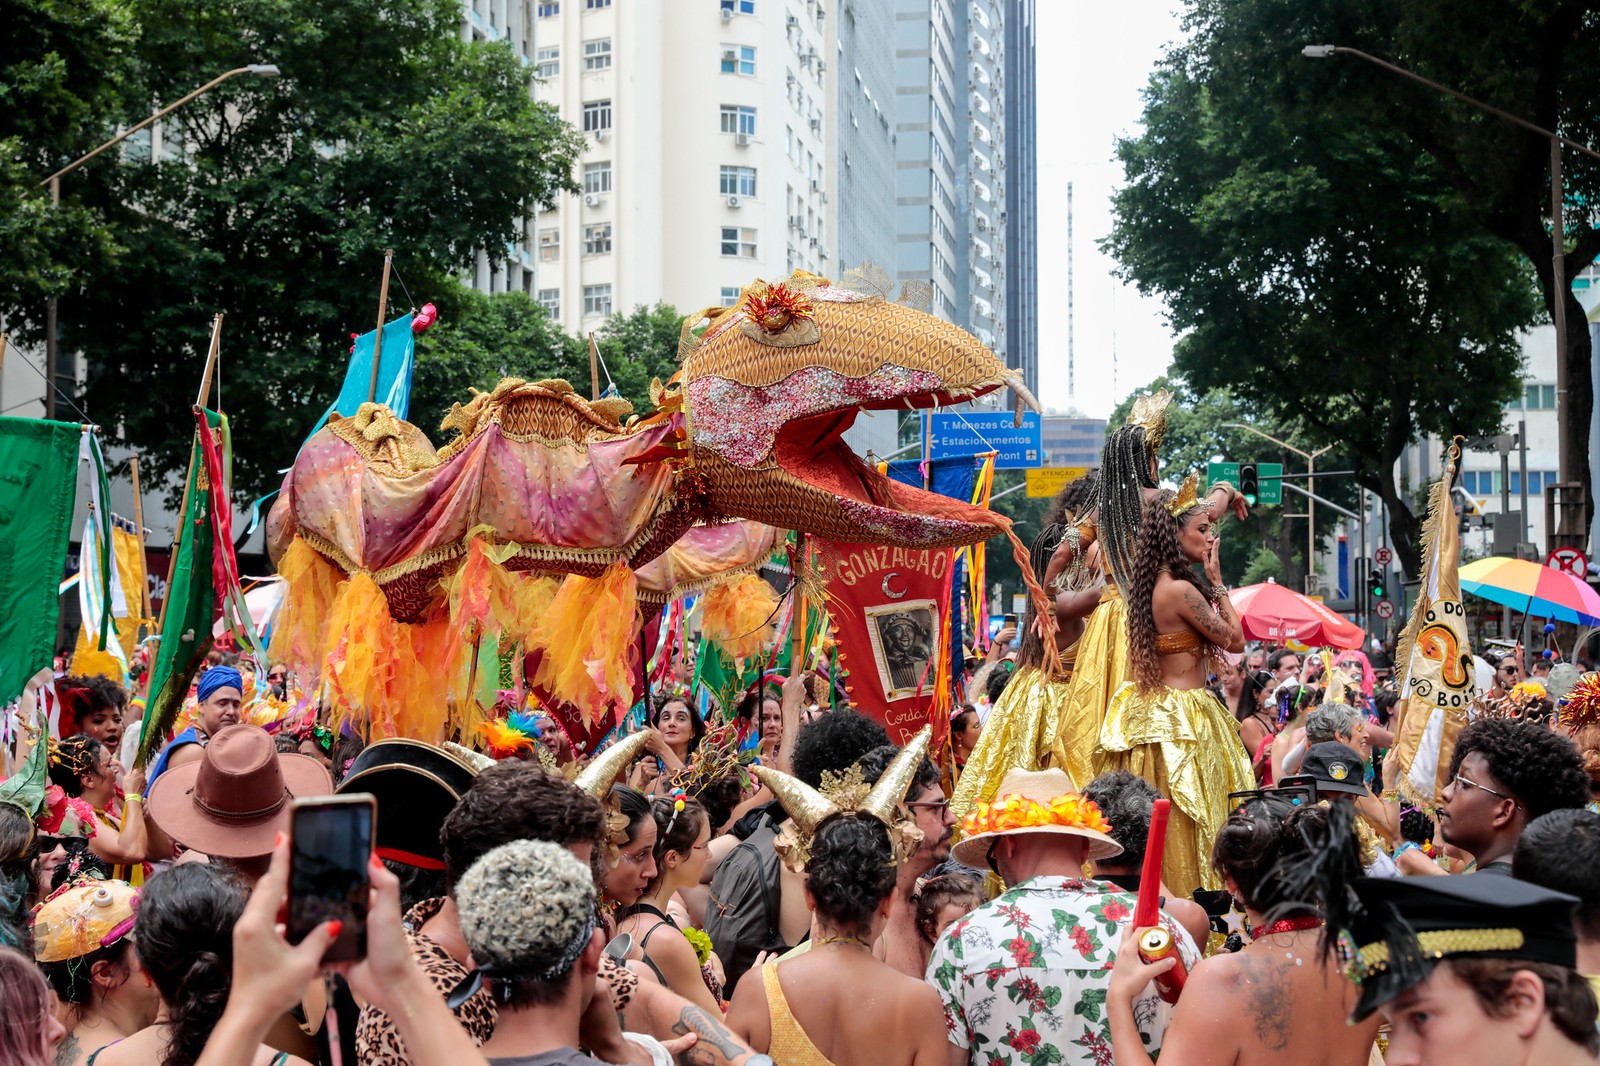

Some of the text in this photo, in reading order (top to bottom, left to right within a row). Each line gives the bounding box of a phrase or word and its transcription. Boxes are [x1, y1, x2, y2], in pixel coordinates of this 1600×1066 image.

[942, 419, 1035, 430] T. Menezes Coes
[942, 435, 1031, 446] Estacionamentos
[1041, 470, 1076, 478] ATENÇÃO
[1444, 601, 1464, 617] DO
